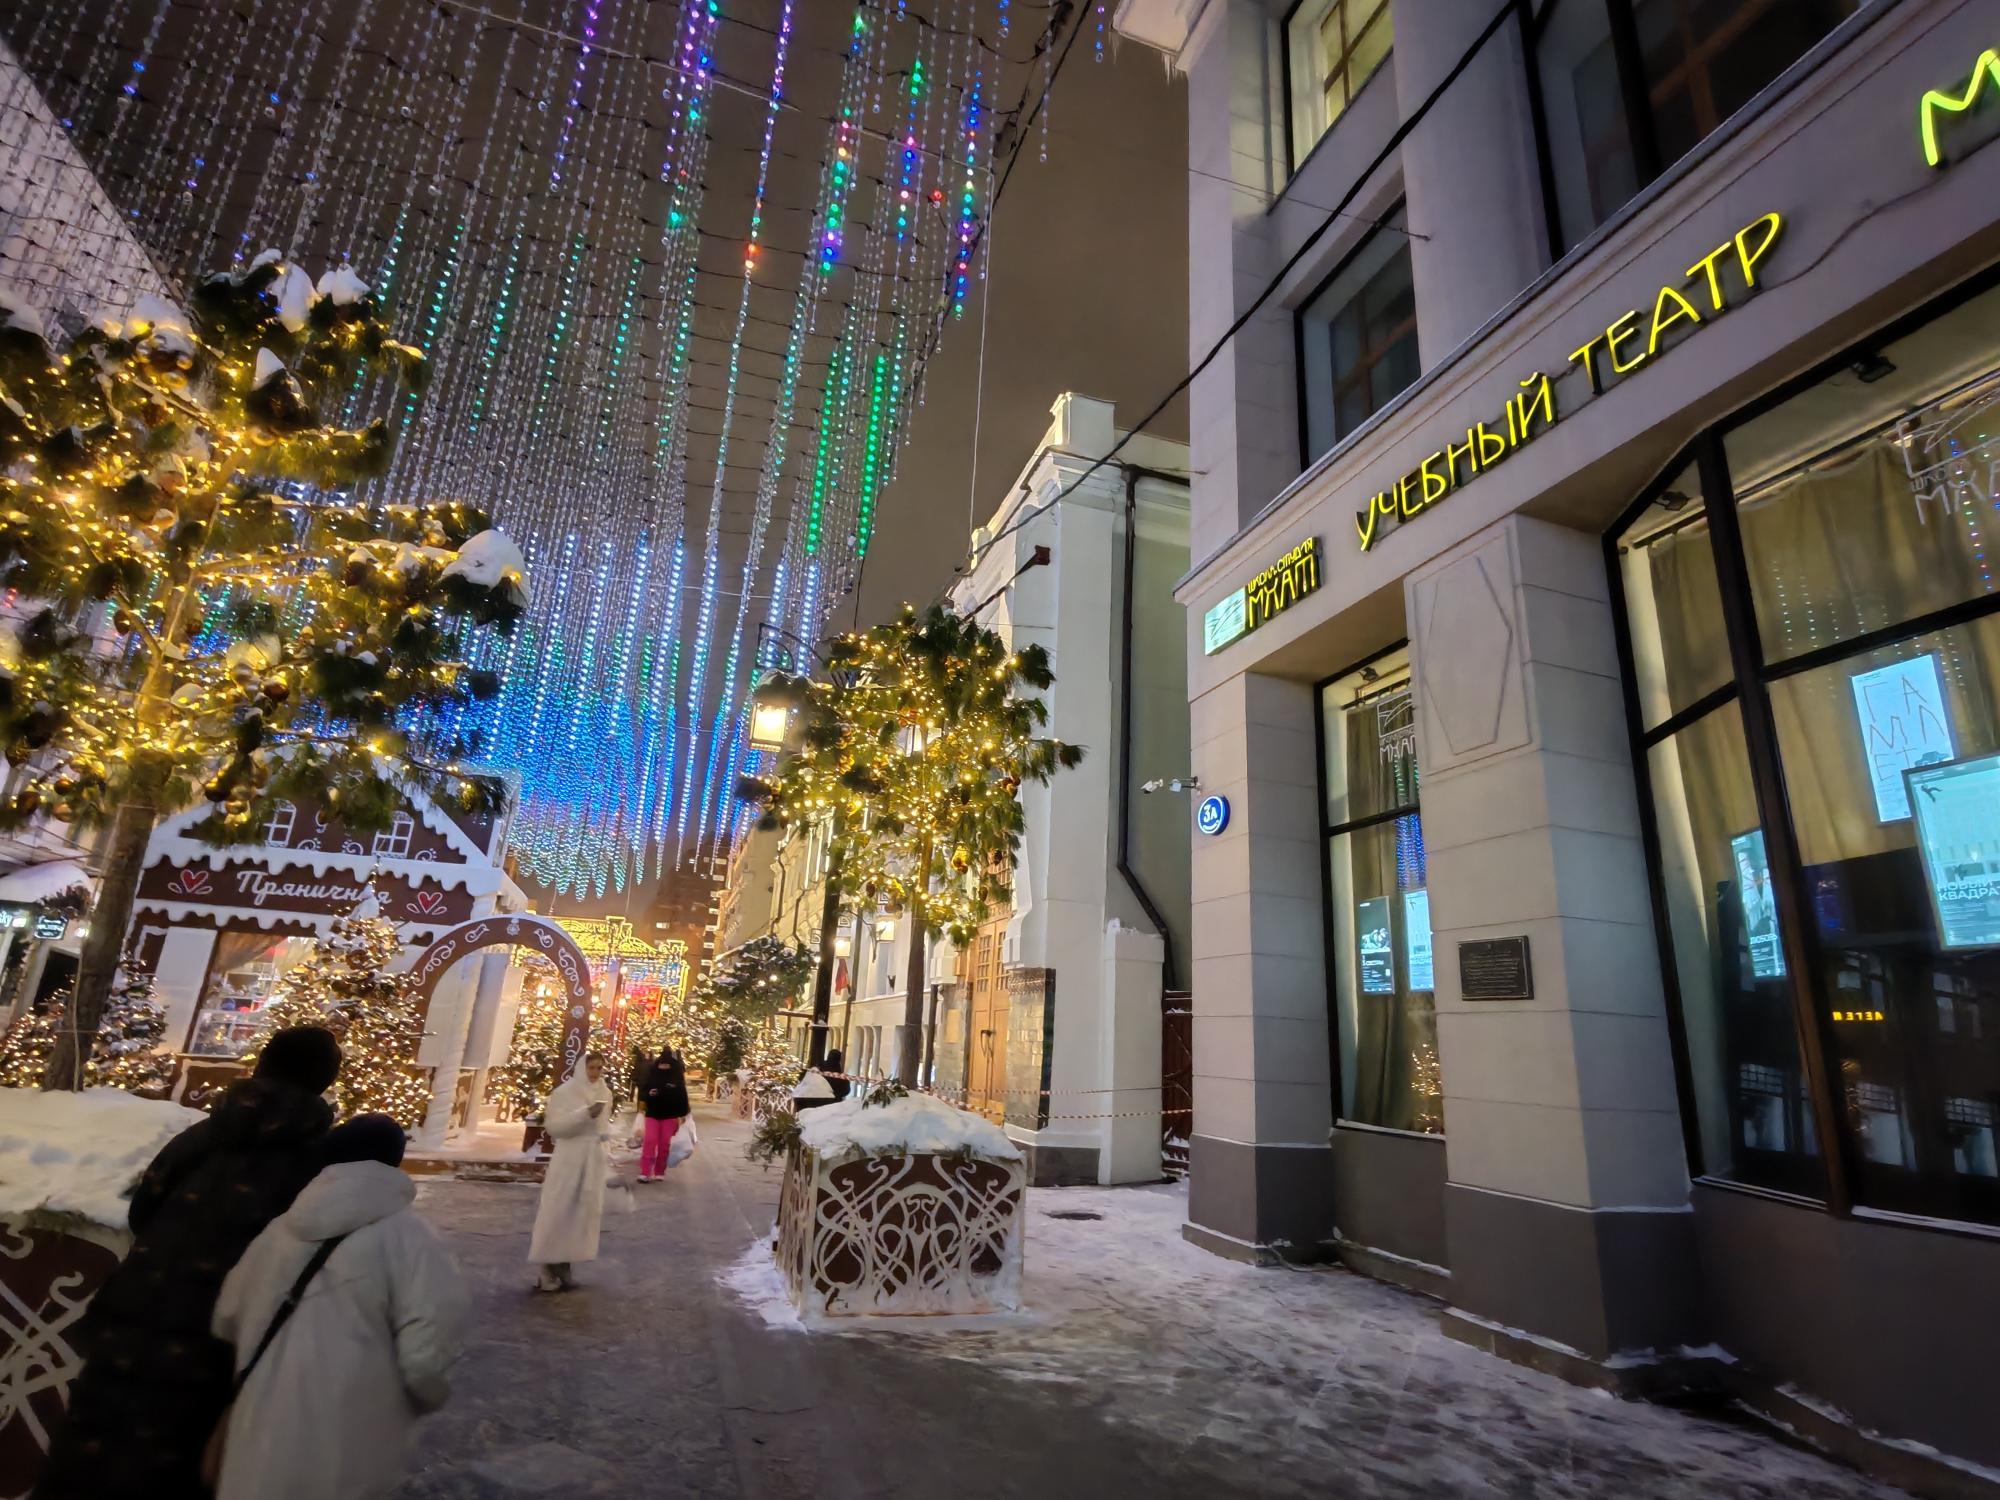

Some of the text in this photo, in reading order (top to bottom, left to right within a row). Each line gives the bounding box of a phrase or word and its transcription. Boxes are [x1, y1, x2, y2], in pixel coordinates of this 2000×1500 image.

[1356, 372, 1553, 552] УЧЕБНЫЙ
[1568, 213, 1780, 391] ТЕАТР
[1249, 553, 1315, 628] МХАТ
[237, 870, 392, 906] Пряничня
[1939, 886, 2000, 902] КВАДРА
